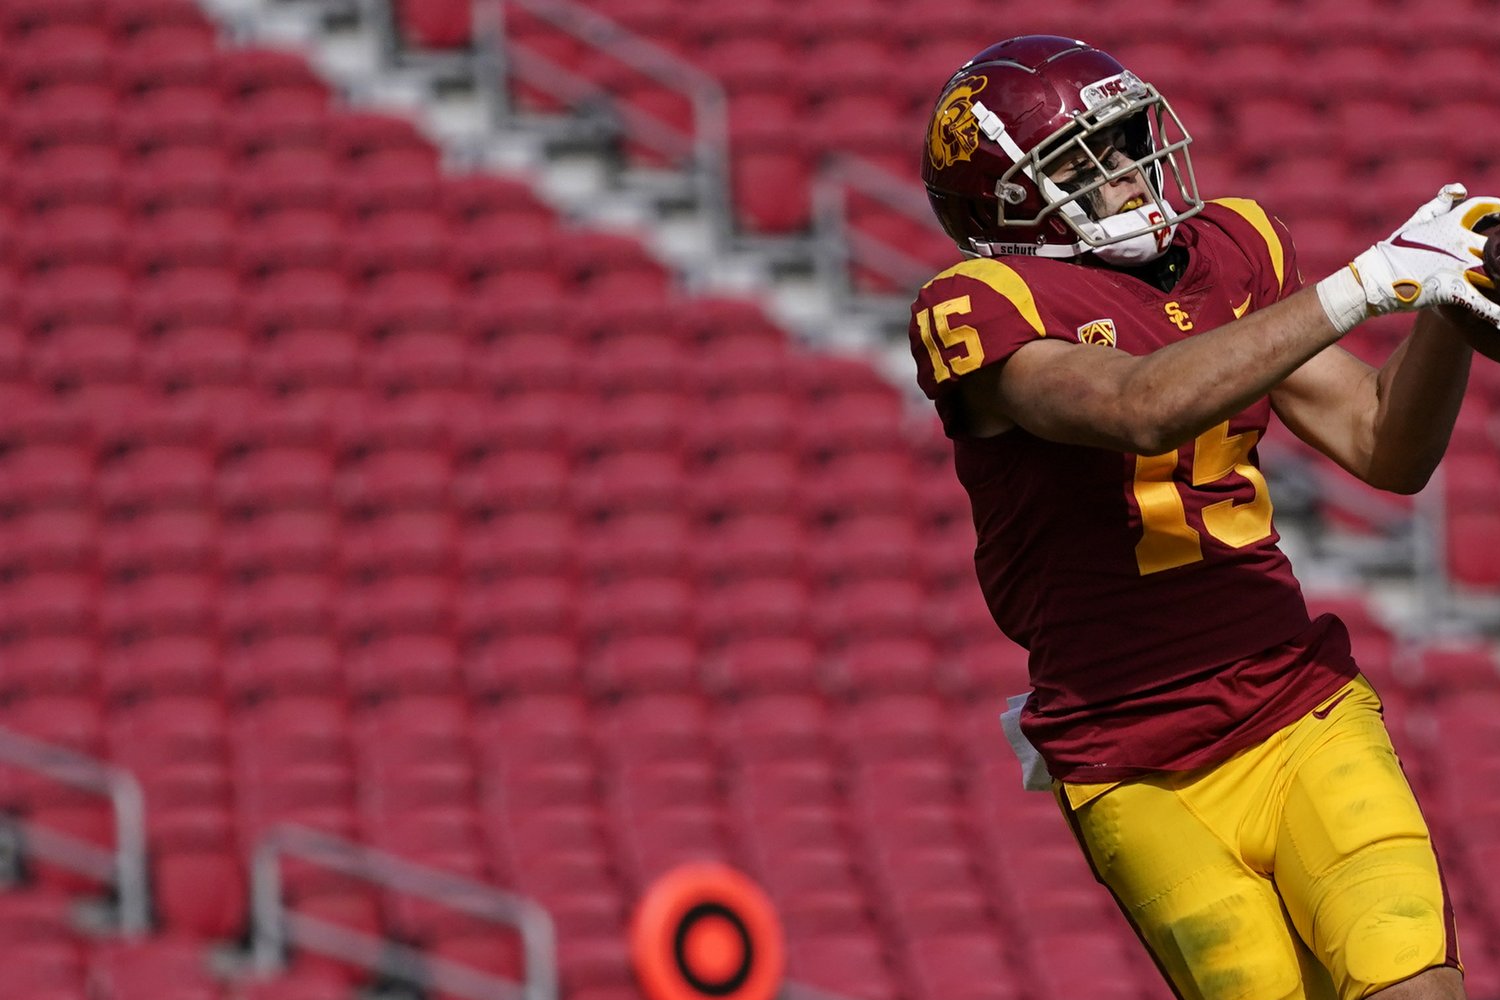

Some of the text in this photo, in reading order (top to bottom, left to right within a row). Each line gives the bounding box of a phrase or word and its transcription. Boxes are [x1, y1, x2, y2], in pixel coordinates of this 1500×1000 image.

[1000, 245, 1038, 256] schutt
[916, 294, 985, 384] 15
[1164, 301, 1193, 331] SC
[1133, 420, 1274, 576] 15
